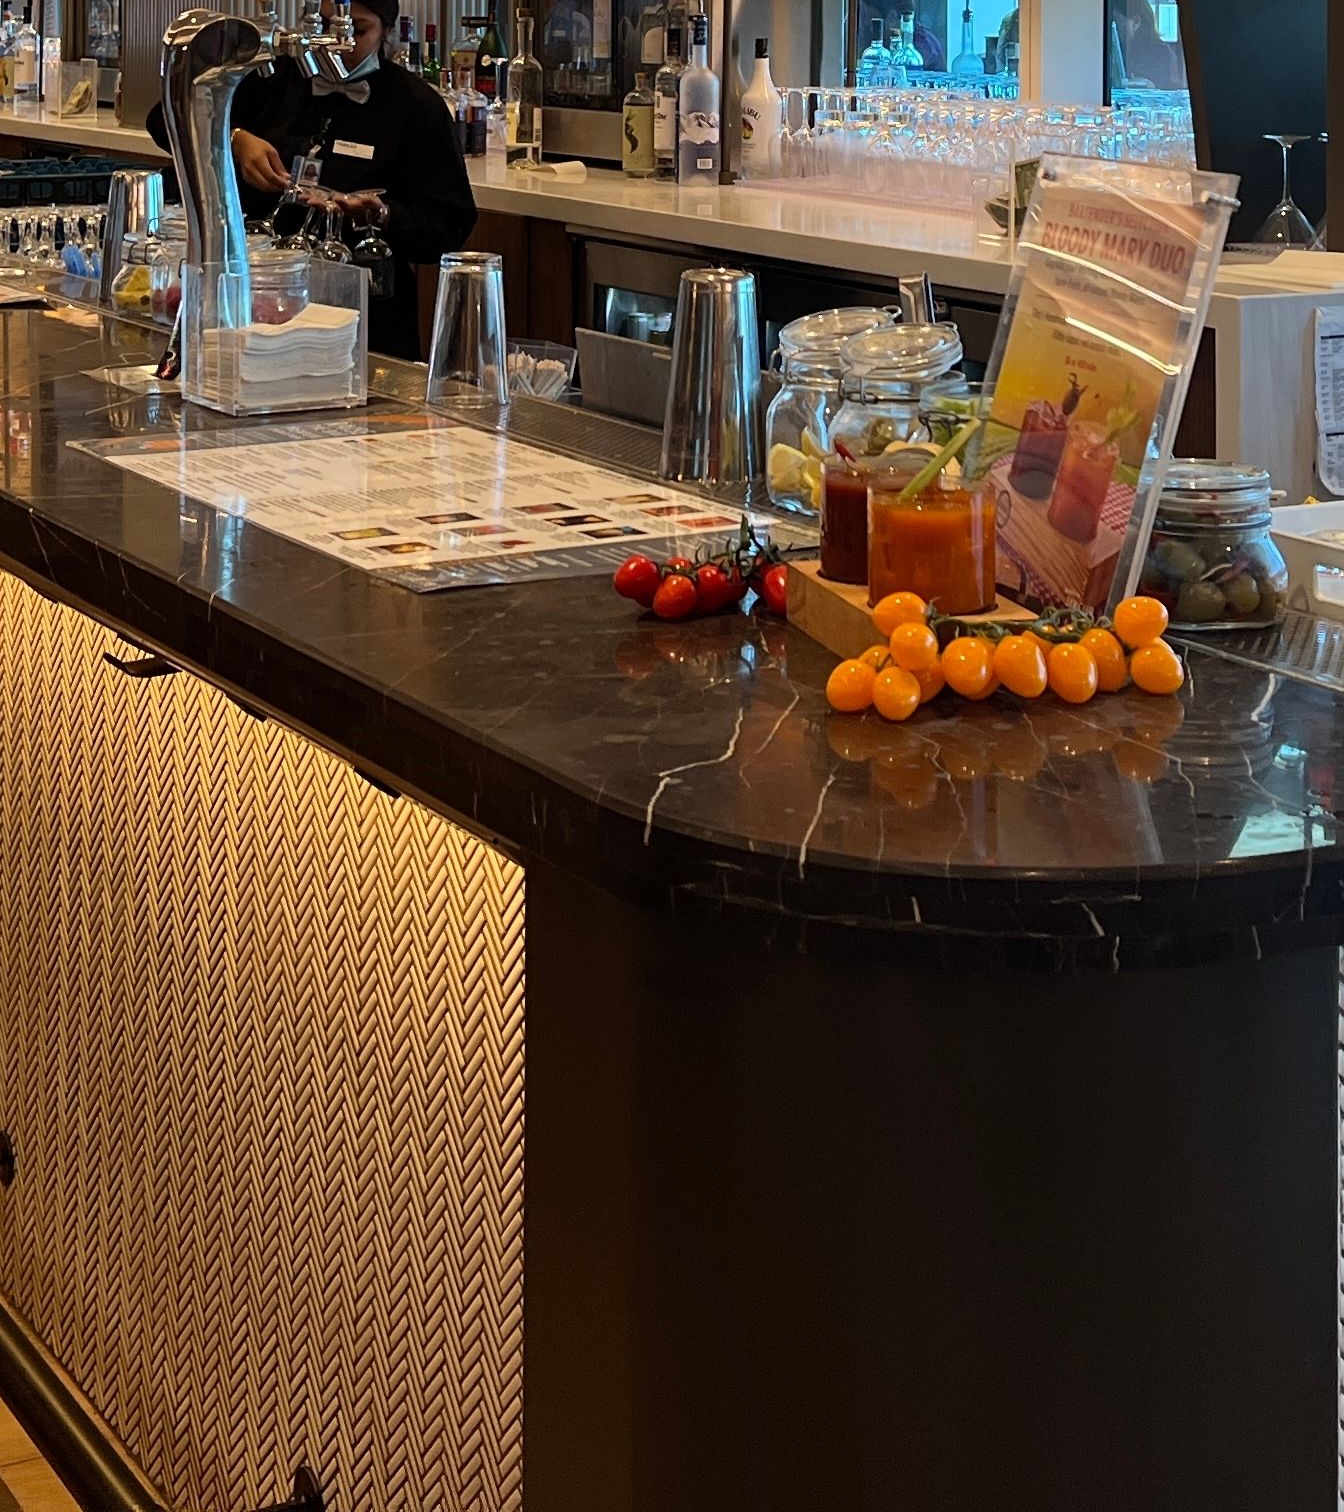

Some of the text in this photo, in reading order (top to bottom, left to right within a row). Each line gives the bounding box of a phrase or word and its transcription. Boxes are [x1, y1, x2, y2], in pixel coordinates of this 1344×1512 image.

[1041, 221, 1187, 275] BLOODY MARY DUO
